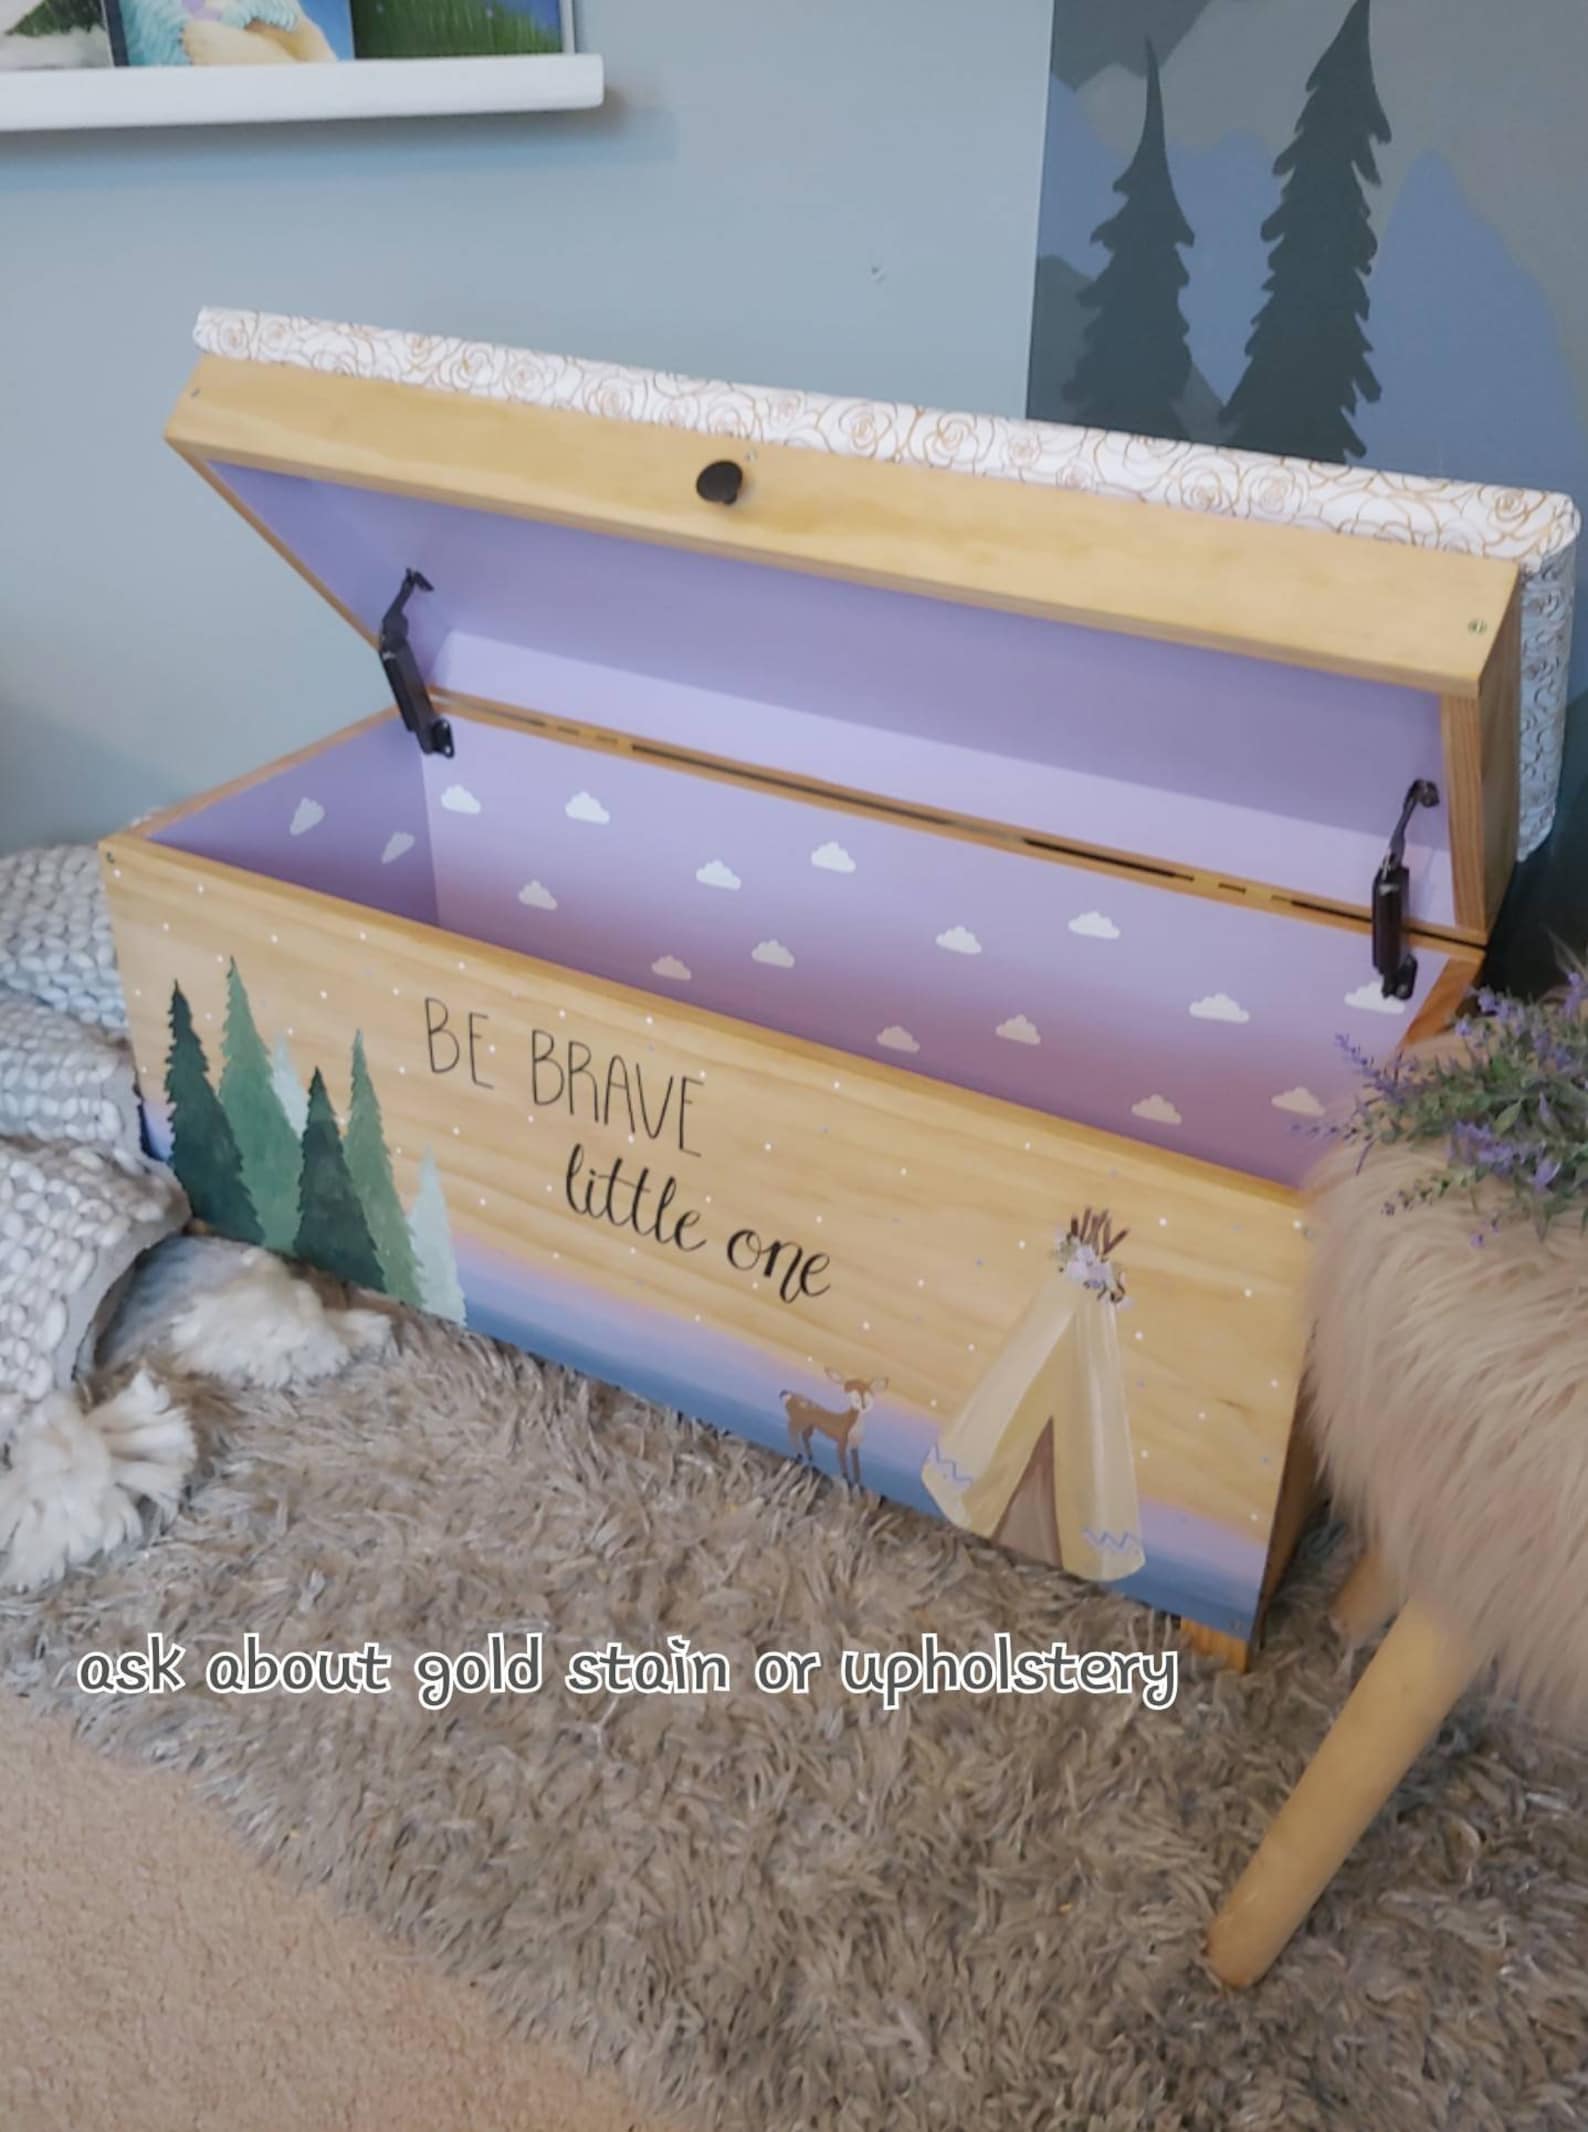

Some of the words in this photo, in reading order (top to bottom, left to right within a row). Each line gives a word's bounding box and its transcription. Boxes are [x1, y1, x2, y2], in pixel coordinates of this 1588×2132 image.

[425, 996, 494, 1089] BE
[531, 1028, 704, 1157] BRAVE
[565, 1143, 707, 1252] little
[726, 1228, 832, 1304] one
